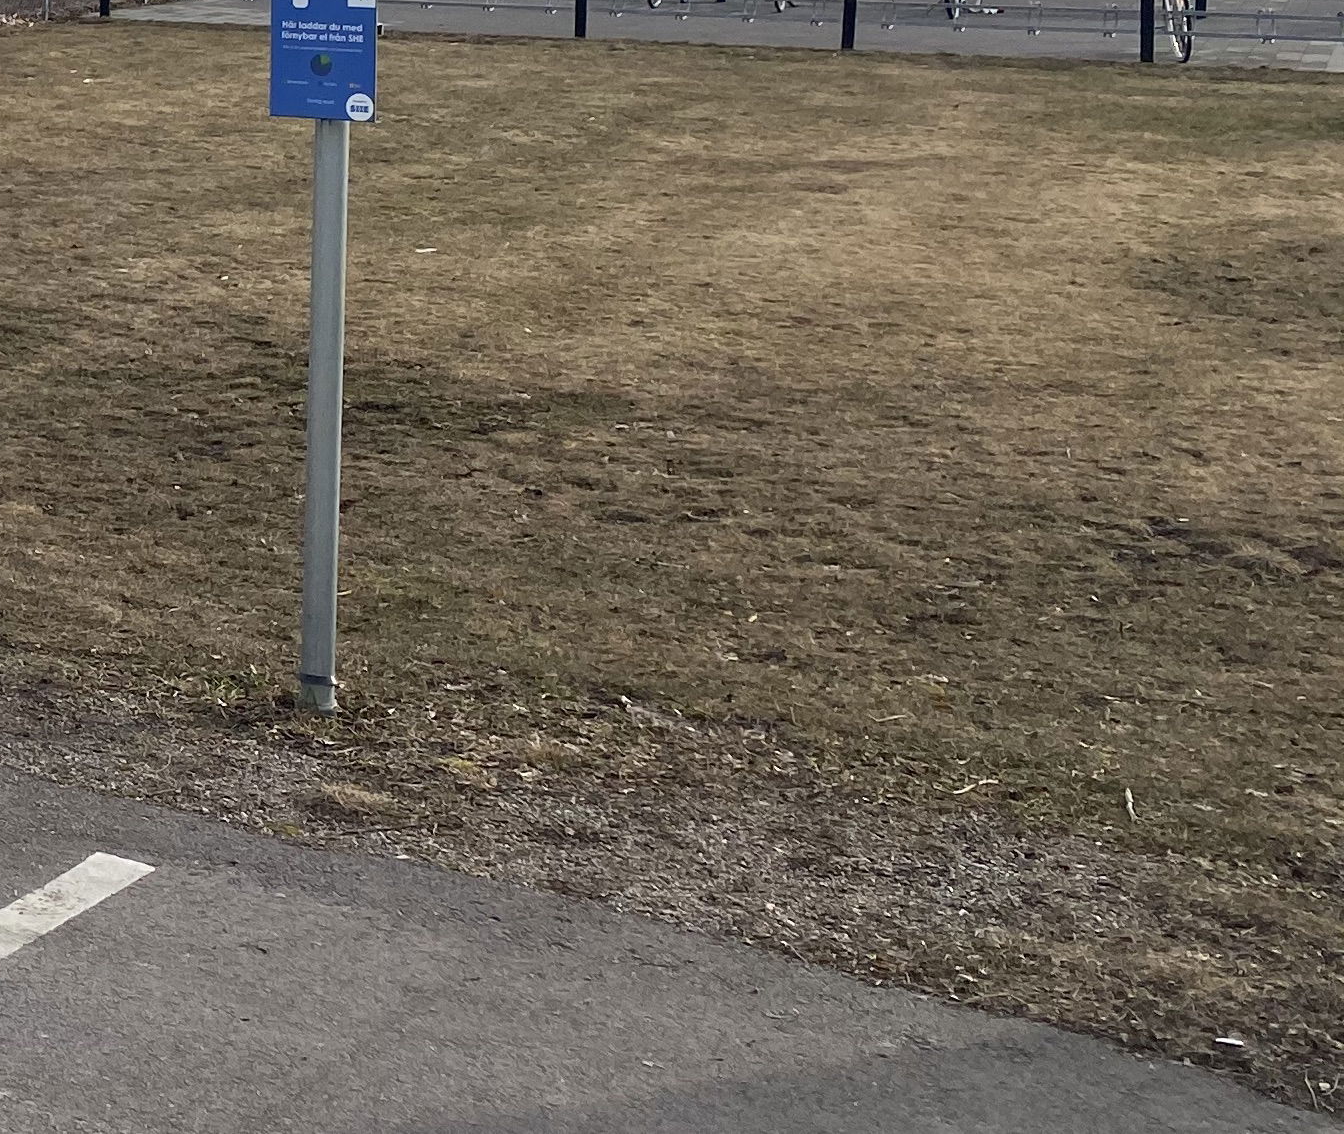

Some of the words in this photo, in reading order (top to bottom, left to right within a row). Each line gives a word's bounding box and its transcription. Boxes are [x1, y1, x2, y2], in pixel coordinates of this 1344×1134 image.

[281, 20, 297, 29] Här
[298, 21, 327, 31] laddar
[329, 22, 341, 32] du
[342, 24, 363, 32] med
[281, 30, 318, 41] förnybar
[319, 33, 328, 41] el
[329, 33, 347, 43] från
